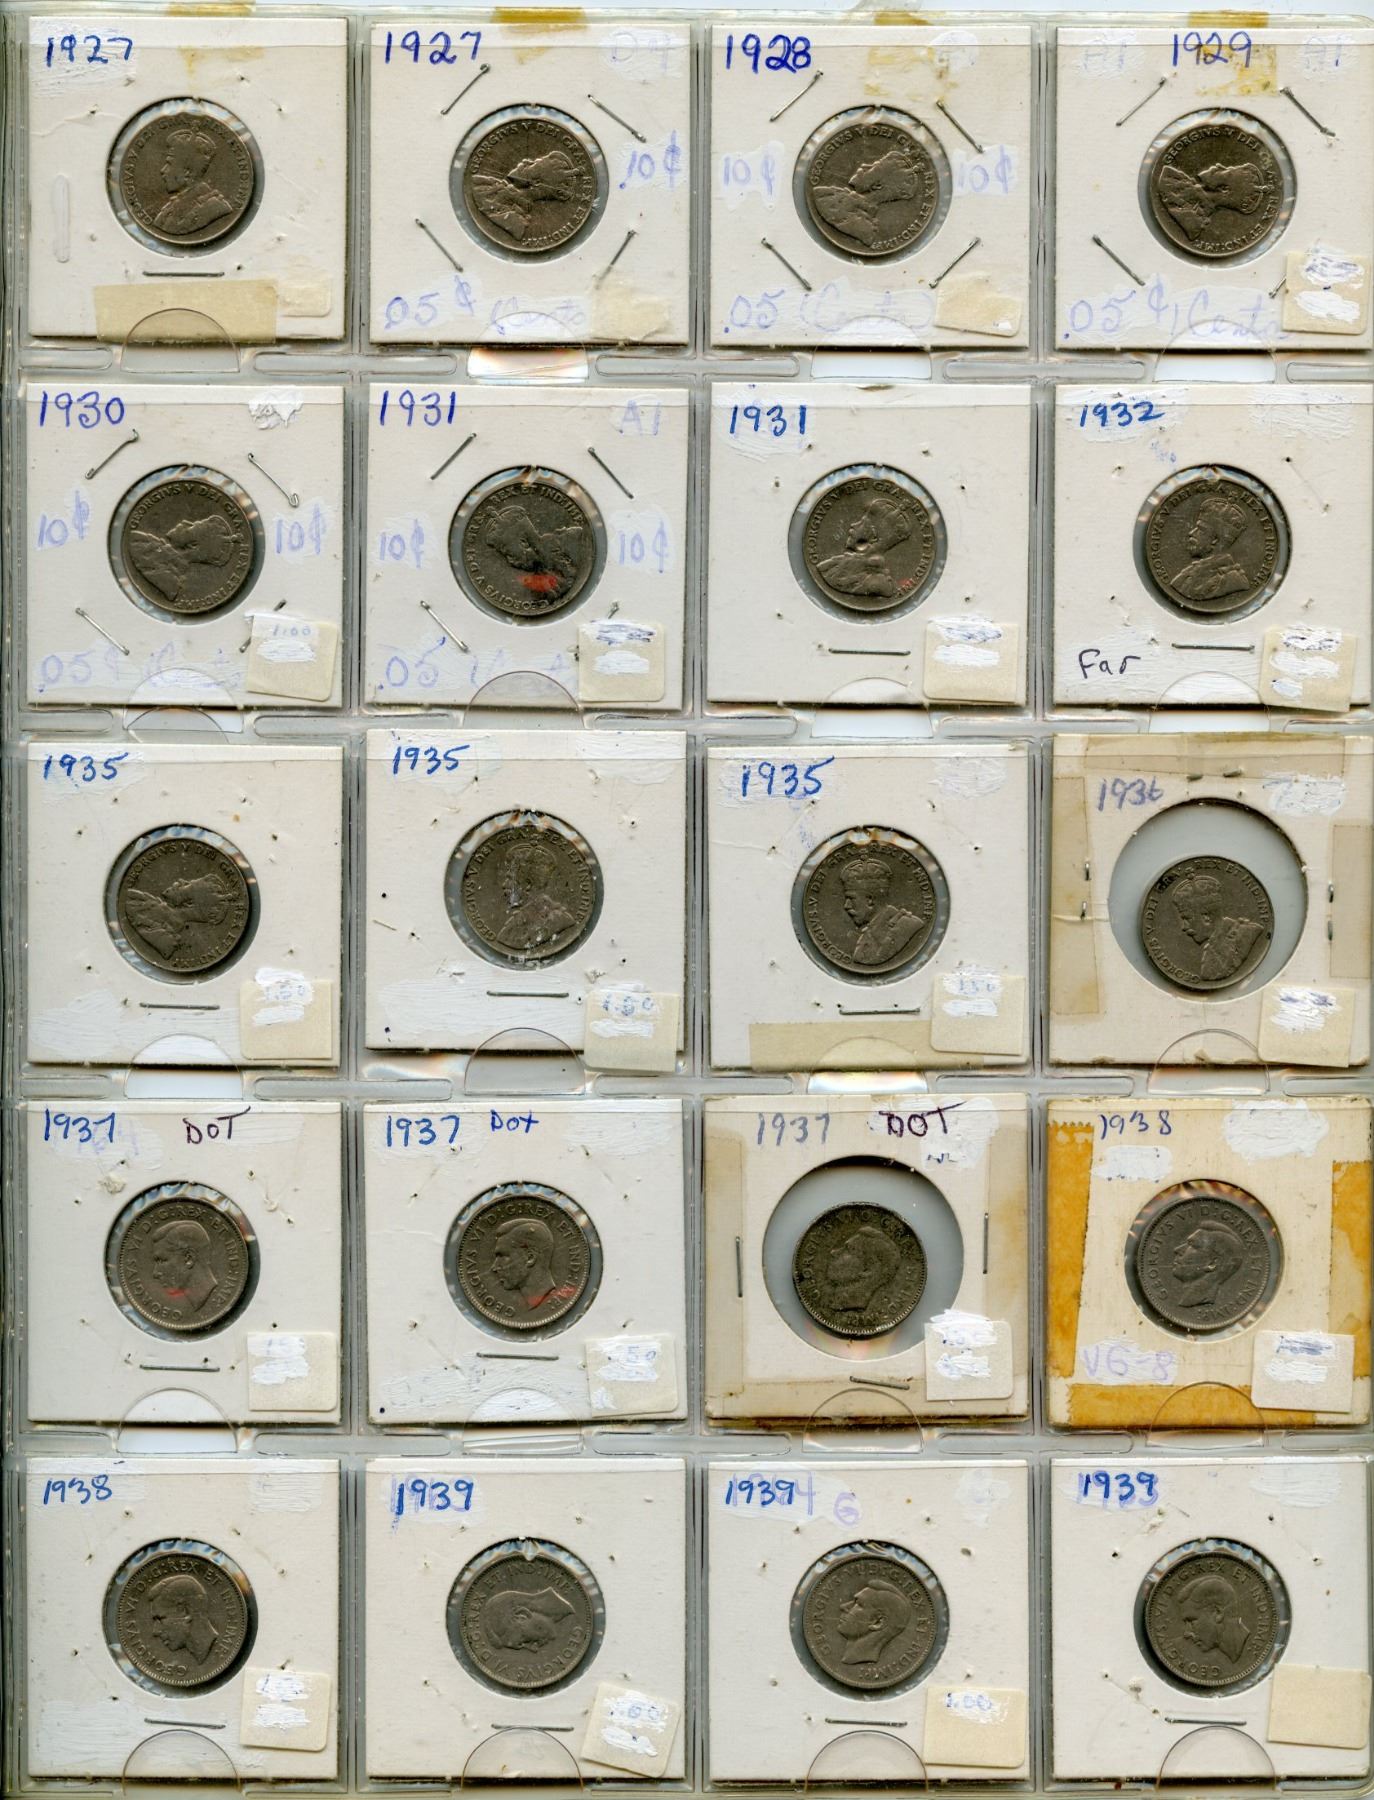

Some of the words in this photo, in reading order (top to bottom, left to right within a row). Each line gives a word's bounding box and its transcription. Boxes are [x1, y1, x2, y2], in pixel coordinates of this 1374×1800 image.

[45, 36, 133, 68] 1927
[386, 31, 481, 66] 1927
[725, 33, 811, 72] 1928
[1173, 32, 1252, 68] 1929
[468, 121, 520, 174] GEORGIVS
[521, 121, 531, 131] V
[535, 122, 561, 138] DEI
[808, 127, 855, 185] GEORGIVS
[852, 125, 866, 137] V
[869, 126, 894, 140] DEI
[1159, 125, 1220, 165] GEORGIVS
[1235, 130, 1262, 153] DEI
[1246, 222, 1265, 241] ET
[39, 391, 125, 428] 1930
[380, 390, 456, 428] 1931
[730, 404, 806, 438] 1931
[1080, 400, 1165, 428] 1932
[126, 482, 181, 529] GEORGIVS
[184, 482, 195, 494] V
[198, 485, 223, 504] DEI
[1159, 506, 1172, 519] V
[1167, 487, 1193, 509] DEI
[807, 497, 834, 564] GEORGIVS
[841, 478, 868, 497] DEI
[1150, 518, 1171, 586] GEORGIVS
[473, 572, 487, 585] V
[43, 752, 129, 782] 1935
[392, 744, 470, 776] 1935
[740, 757, 835, 796] 1935
[1097, 778, 1163, 812] 1936
[468, 864, 480, 876] V
[1144, 924, 1154, 936] V
[1223, 861, 1243, 878] ET
[44, 1108, 117, 1143] 1937
[185, 1106, 252, 1145] DOT
[386, 1114, 460, 1148] 1937
[757, 1112, 830, 1147] 1937
[878, 1102, 966, 1139] DOT
[1099, 1110, 1174, 1142] 1938
[126, 1232, 144, 1253] VI
[209, 1215, 231, 1237] ET
[467, 1222, 488, 1245] VI
[554, 1218, 576, 1241] ET
[1145, 1217, 1176, 1304] GEORGIVS
[125, 1256, 183, 1322] GEORGIVS
[465, 1246, 516, 1319] GEORGIVS
[43, 1475, 113, 1506] 1938
[393, 1478, 475, 1518] 1939
[724, 1477, 796, 1508] 1939
[123, 1594, 140, 1615] VI
[201, 1567, 224, 1588] ET
[1231, 1566, 1252, 1586] ET
